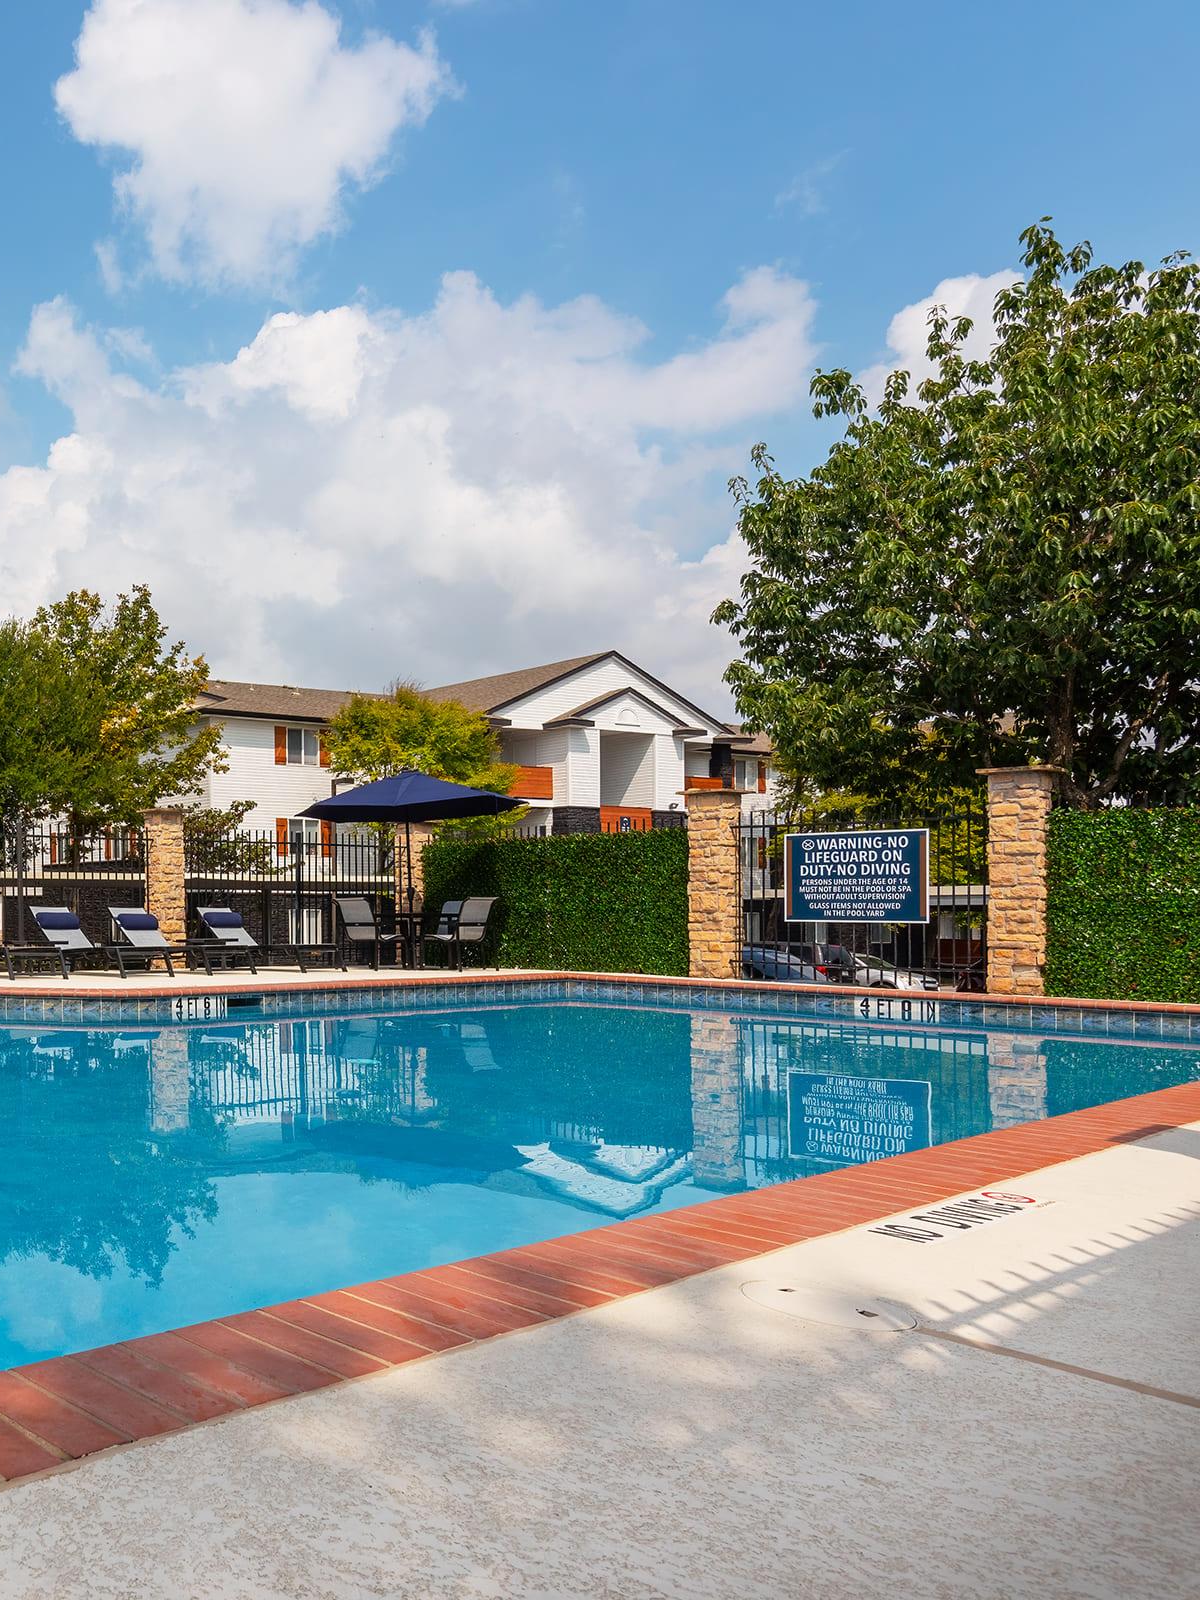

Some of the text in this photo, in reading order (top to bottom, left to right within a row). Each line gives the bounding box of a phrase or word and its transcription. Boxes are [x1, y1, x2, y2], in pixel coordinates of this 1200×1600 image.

[816, 835, 909, 850] WARNING-NO
[804, 849, 903, 864] LIFEGUARD ON
[800, 863, 911, 876] DUTY-NO DIVING
[867, 1199, 1024, 1243] NO DIVING
